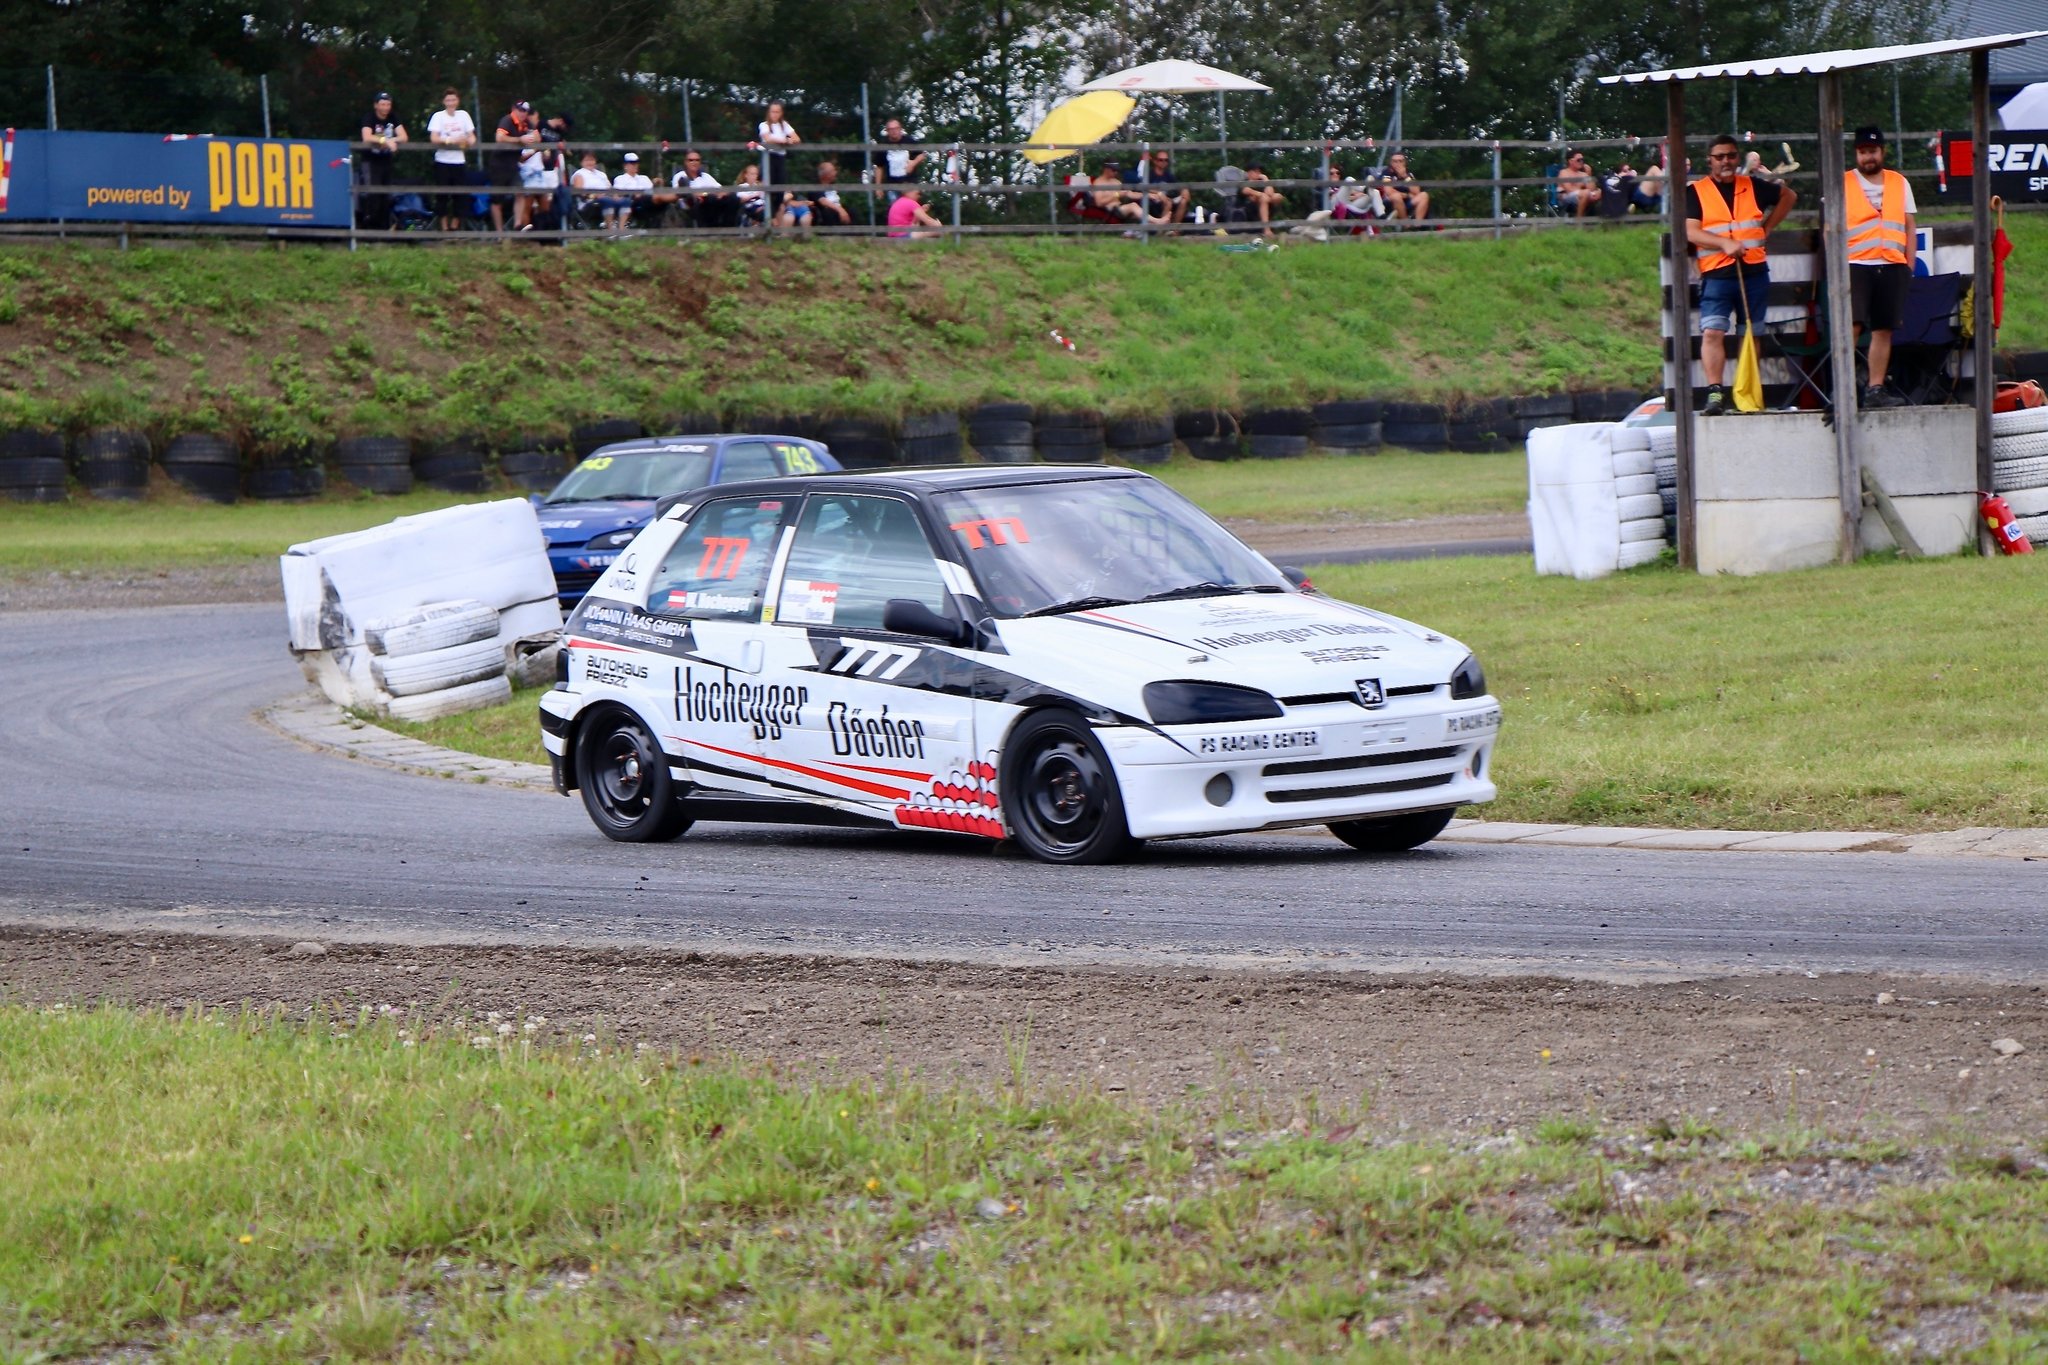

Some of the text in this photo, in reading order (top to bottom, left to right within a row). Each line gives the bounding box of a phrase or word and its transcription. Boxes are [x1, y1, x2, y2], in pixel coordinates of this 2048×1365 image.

[209, 141, 313, 212] PORR
[88, 184, 191, 210] powered by
[776, 445, 817, 474] 743
[948, 517, 1031, 550] 777
[695, 536, 751, 581] 777
[583, 605, 688, 638] JOHANN HAAS GMBH
[1193, 628, 1319, 650] Hochegger
[831, 637, 922, 680] 777
[674, 666, 808, 740] Hochegger
[828, 701, 925, 760] Dächer
[1200, 730, 1320, 753] PS RACING CENTER
